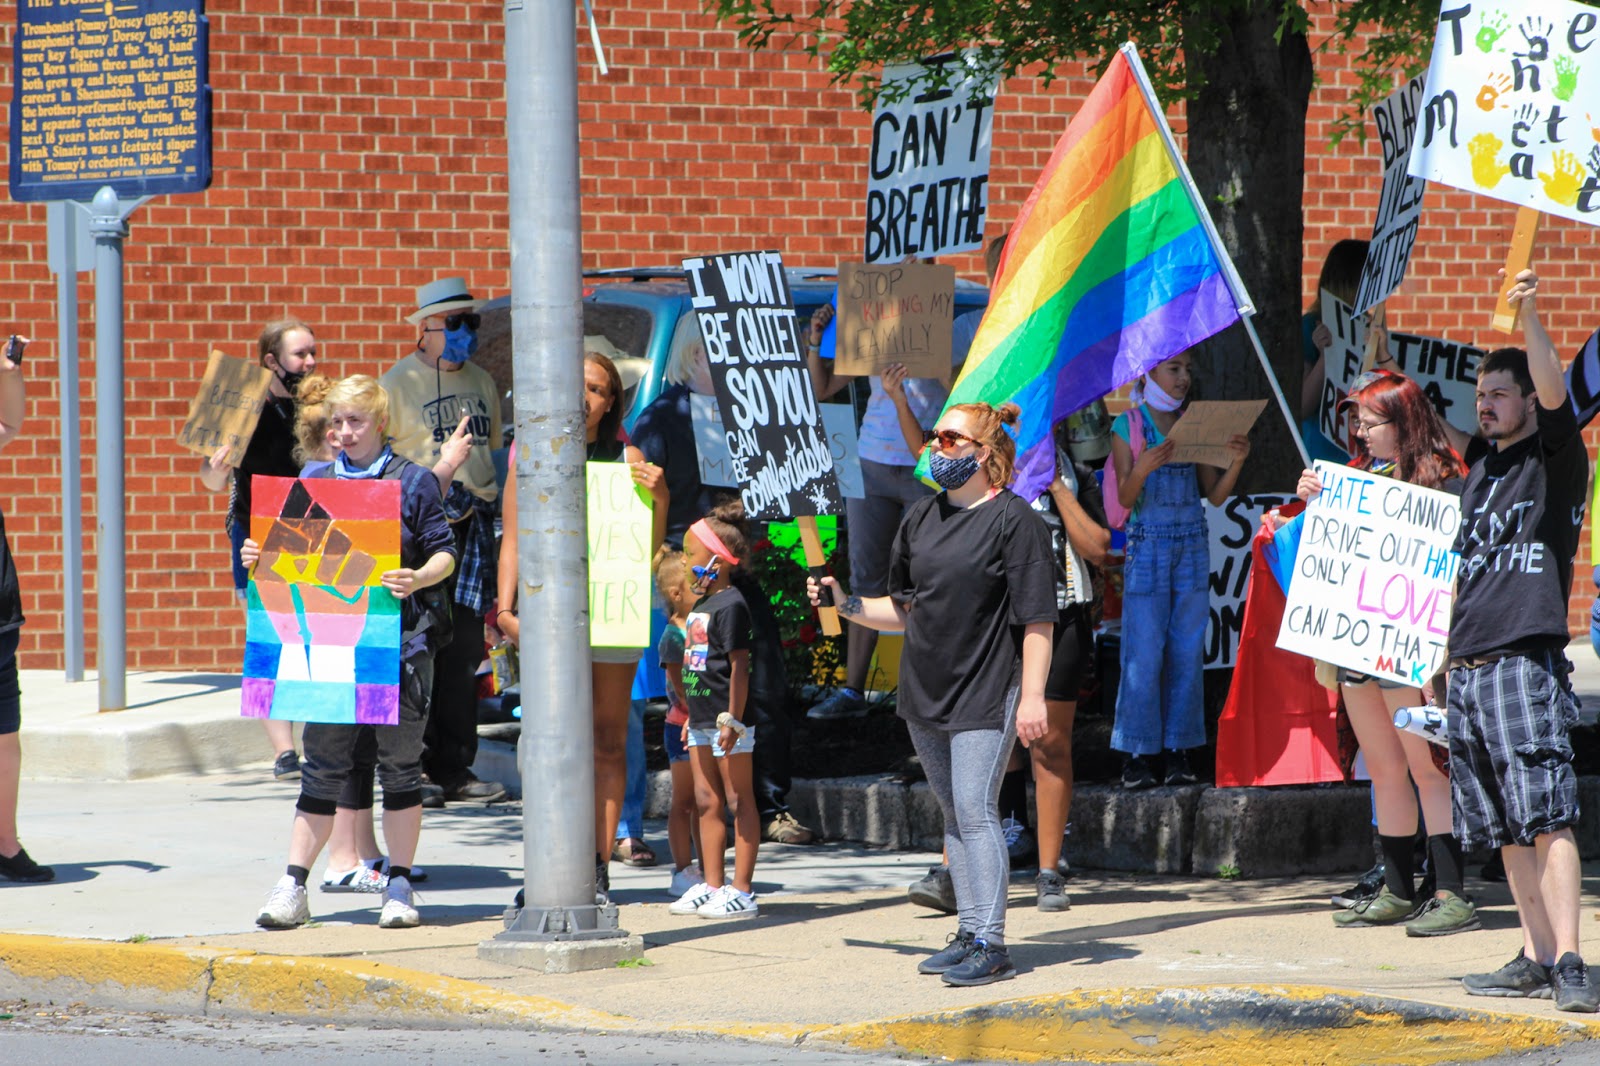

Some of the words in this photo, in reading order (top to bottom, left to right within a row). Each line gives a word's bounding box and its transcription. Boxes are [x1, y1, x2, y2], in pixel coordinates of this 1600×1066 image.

[22, 21, 74, 36] Trombonist
[75, 18, 109, 32] Tommy
[109, 16, 143, 29] Dorsey
[22, 34, 75, 51] saxophonist
[78, 32, 109, 46] Jimmy
[112, 29, 146, 43] Dorsey
[150, 24, 197, 39] (1904-57)
[22, 53, 44, 63] were
[47, 49, 66, 63] key
[70, 47, 104, 61] figures
[107, 44, 119, 57] of
[124, 43, 140, 56] the
[22, 67, 40, 77] era.
[43, 62, 66, 76] Born
[69, 60, 98, 73] within
[102, 59, 127, 71] three
[130, 56, 154, 69] miles
[157, 54, 169, 67] of
[21, 93, 56, 104] careers
[61, 90, 72, 102] in
[77, 85, 136, 101] Shenandoah.
[144, 82, 169, 96] Until
[22, 78, 44, 90] both
[45, 78, 68, 92] grew
[71, 77, 84, 89] up
[87, 73, 104, 86] and
[106, 72, 135, 87] began
[137, 70, 160, 83] their
[163, 66, 197, 81] musical
[22, 106, 37, 118] the
[37, 104, 77, 117] brothers
[77, 99, 126, 117] performed
[127, 97, 168, 113] together.
[171, 95, 197, 109] They
[22, 119, 37, 132] led
[42, 117, 82, 133] separate
[86, 114, 136, 128] orchestras
[141, 111, 174, 125] during
[181, 109, 197, 121] the
[21, 133, 42, 146] next
[58, 133, 86, 145] years
[88, 128, 120, 142] before
[123, 126, 149, 140] being
[152, 122, 197, 137] reunited.
[21, 145, 48, 159] Frank
[52, 144, 87, 158] Sinatra
[91, 145, 108, 155] was
[111, 144, 118, 154] a
[121, 138, 163, 153] featured
[166, 138, 197, 153] singer
[871, 98, 994, 180] CAN'T
[21, 159, 43, 172] with
[45, 157, 86, 173] Tommy's
[866, 174, 988, 264] BREATHE
[682, 258, 716, 309] I
[851, 268, 903, 300] STOP
[930, 292, 953, 318] MY
[698, 312, 740, 365] BE
[736, 307, 801, 364] QUIET
[856, 323, 932, 360] FAMILY
[1391, 333, 1485, 386] TIME
[725, 366, 770, 431] SO
[764, 366, 817, 427] YOU
[726, 428, 761, 459] CAN
[732, 457, 753, 483] BE
[741, 425, 833, 517] comfortable
[1383, 486, 1461, 535] CANNO
[1305, 514, 1373, 560] DRIVE
[1380, 533, 1426, 568] OUT
[1424, 544, 1461, 583] HAT
[589, 579, 640, 624] TER
[1301, 554, 1352, 587] ONLY
[1357, 566, 1453, 637] LOVE
[1288, 605, 1329, 638] CAN
[1332, 613, 1369, 646] DO
[1380, 624, 1445, 672] THAT
